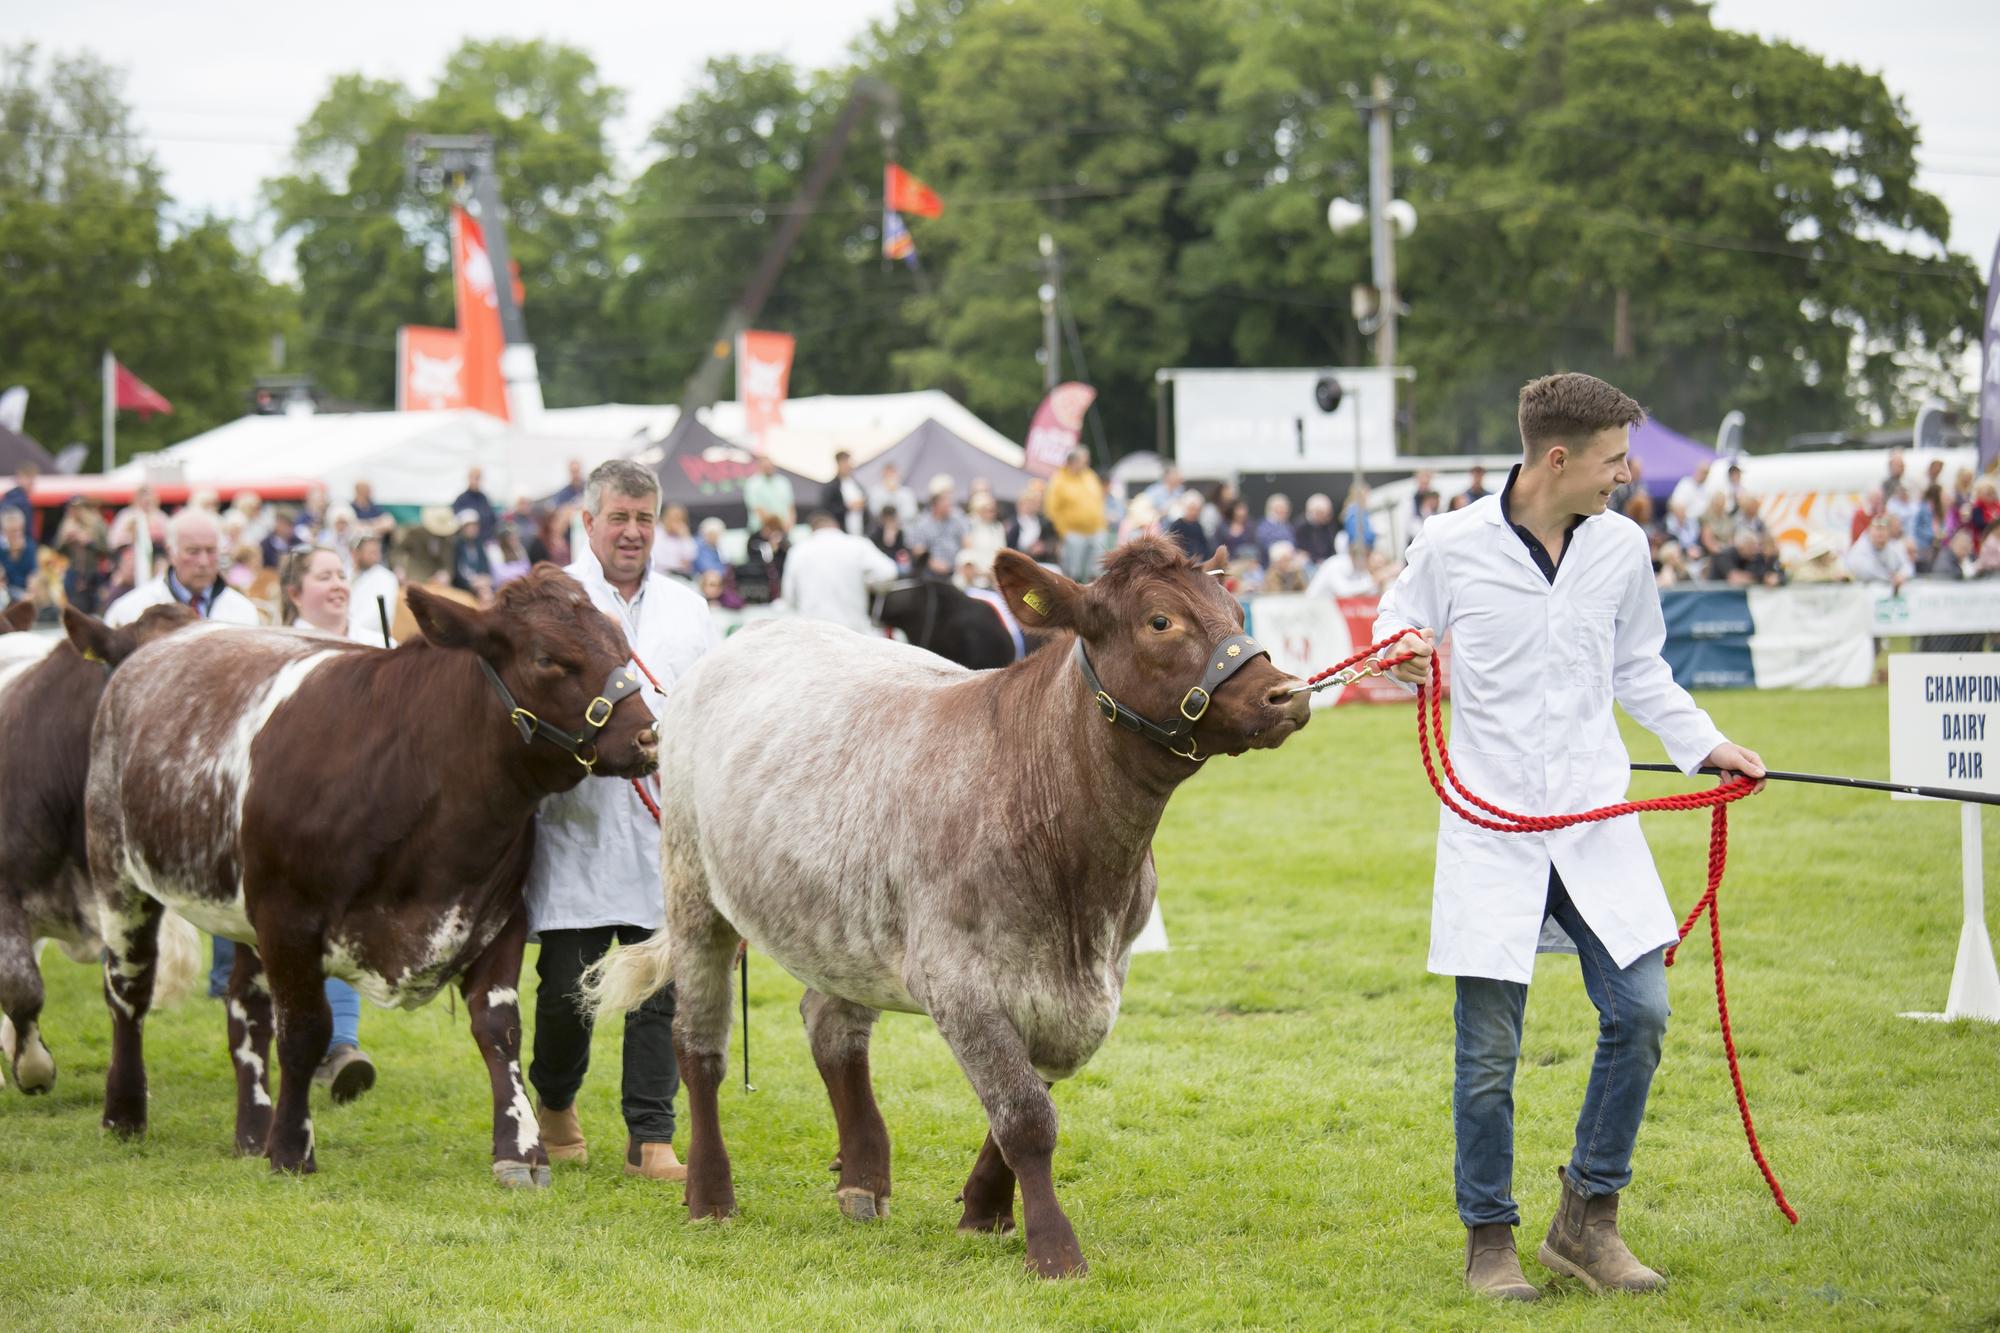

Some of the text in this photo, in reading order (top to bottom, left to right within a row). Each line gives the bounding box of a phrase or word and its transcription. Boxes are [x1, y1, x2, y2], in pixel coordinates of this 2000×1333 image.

[1925, 676, 2000, 703] CHAMPION
[1943, 714, 1986, 741] DAIRY
[1948, 752, 1983, 779] PAIR
